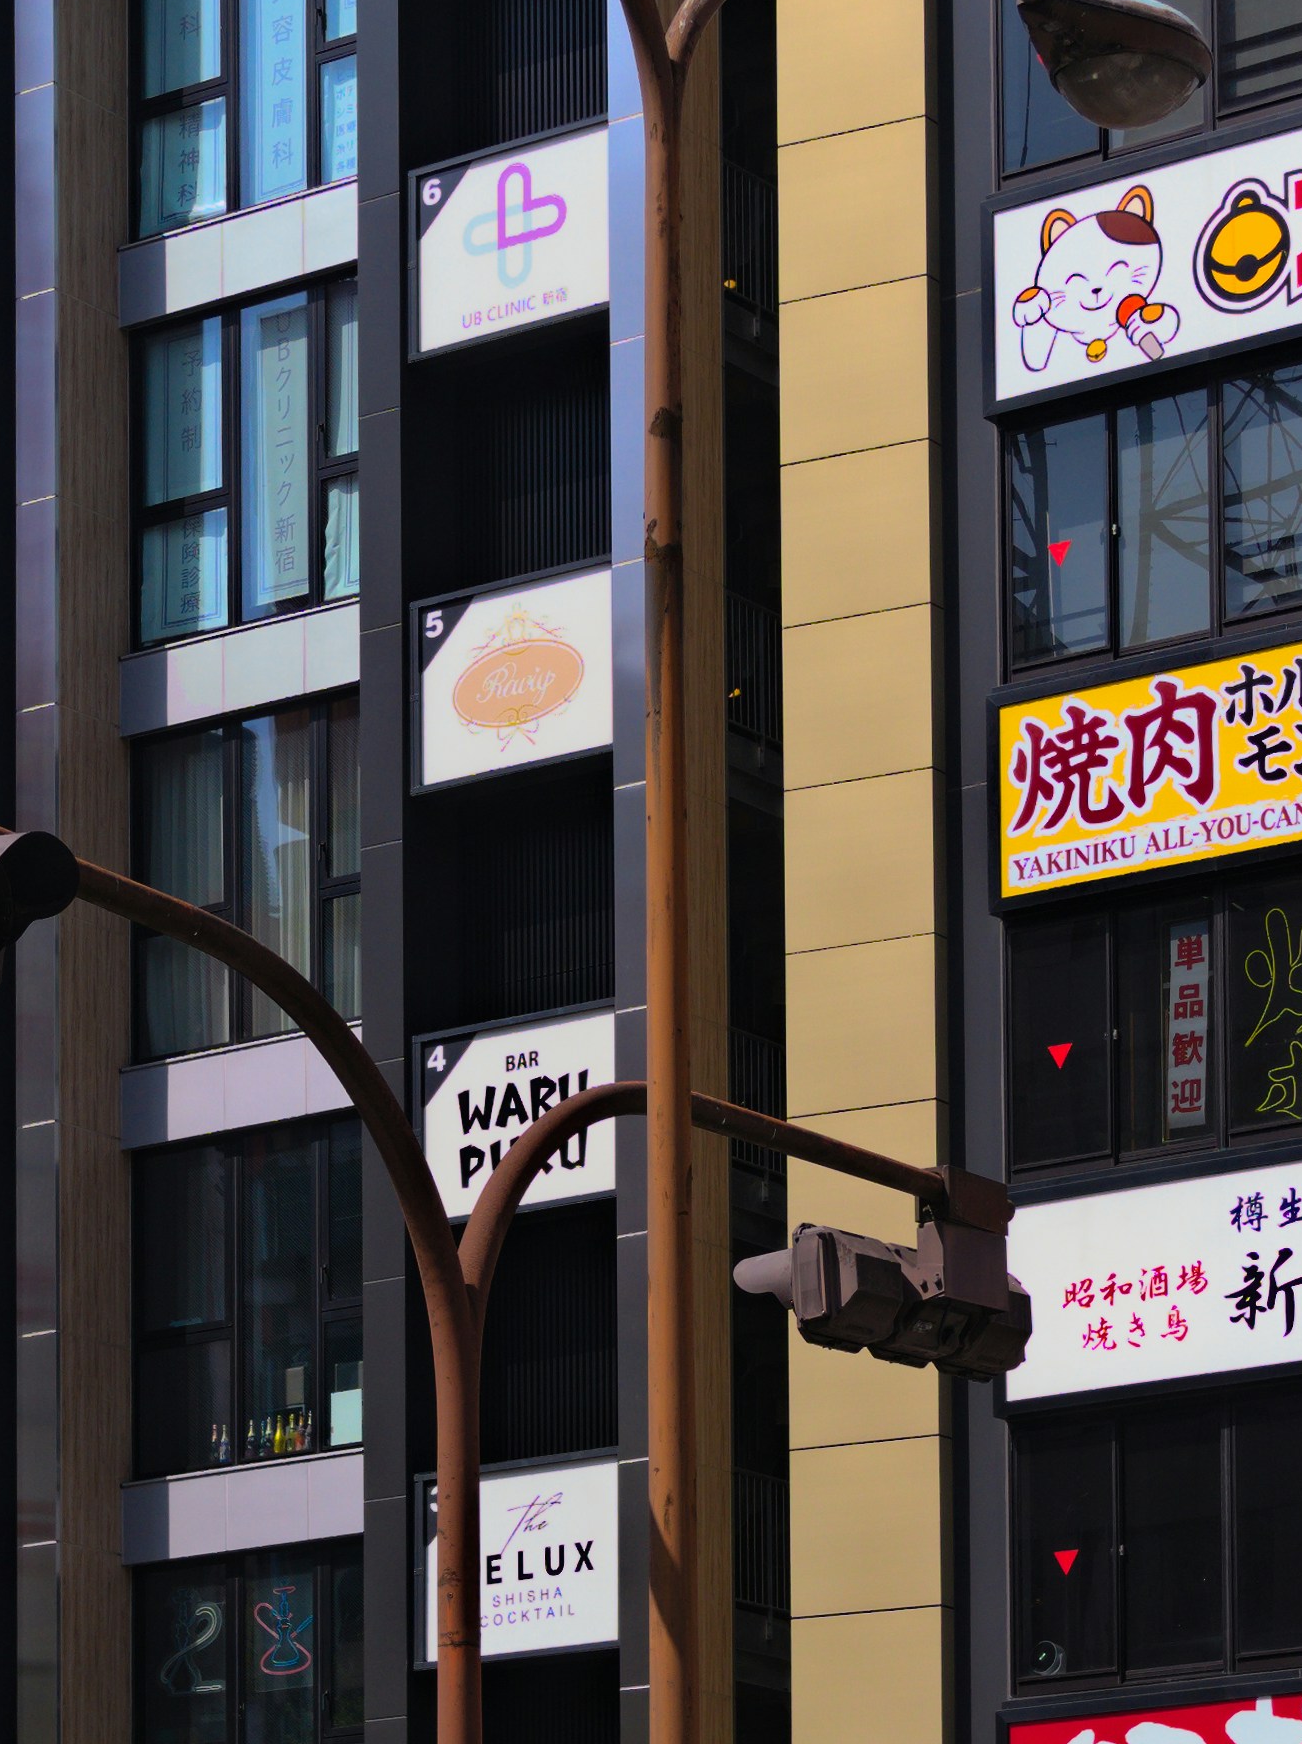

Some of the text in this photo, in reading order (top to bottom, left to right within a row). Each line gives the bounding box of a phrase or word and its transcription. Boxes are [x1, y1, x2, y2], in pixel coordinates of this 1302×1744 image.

[177, 112, 201, 209] 精神科
[421, 176, 443, 207] 6
[461, 308, 485, 331] UB
[486, 293, 537, 323] CLINIC
[180, 349, 203, 454] 予約制
[425, 610, 444, 639] 5
[1012, 682, 1218, 835] 焼肉
[1012, 832, 1137, 881] YAKINIKU
[1172, 933, 1207, 1117] 単品歓迎
[427, 1045, 447, 1072] 4
[505, 1050, 539, 1072] BAR
[1061, 1260, 1210, 1311] 昭和酒場
[1082, 1305, 1190, 1352] 焼き鳥
[485, 1539, 595, 1585] ELUX
[480, 1604, 575, 1629] COCKTAIL
[492, 1586, 563, 1609] SHISHA
